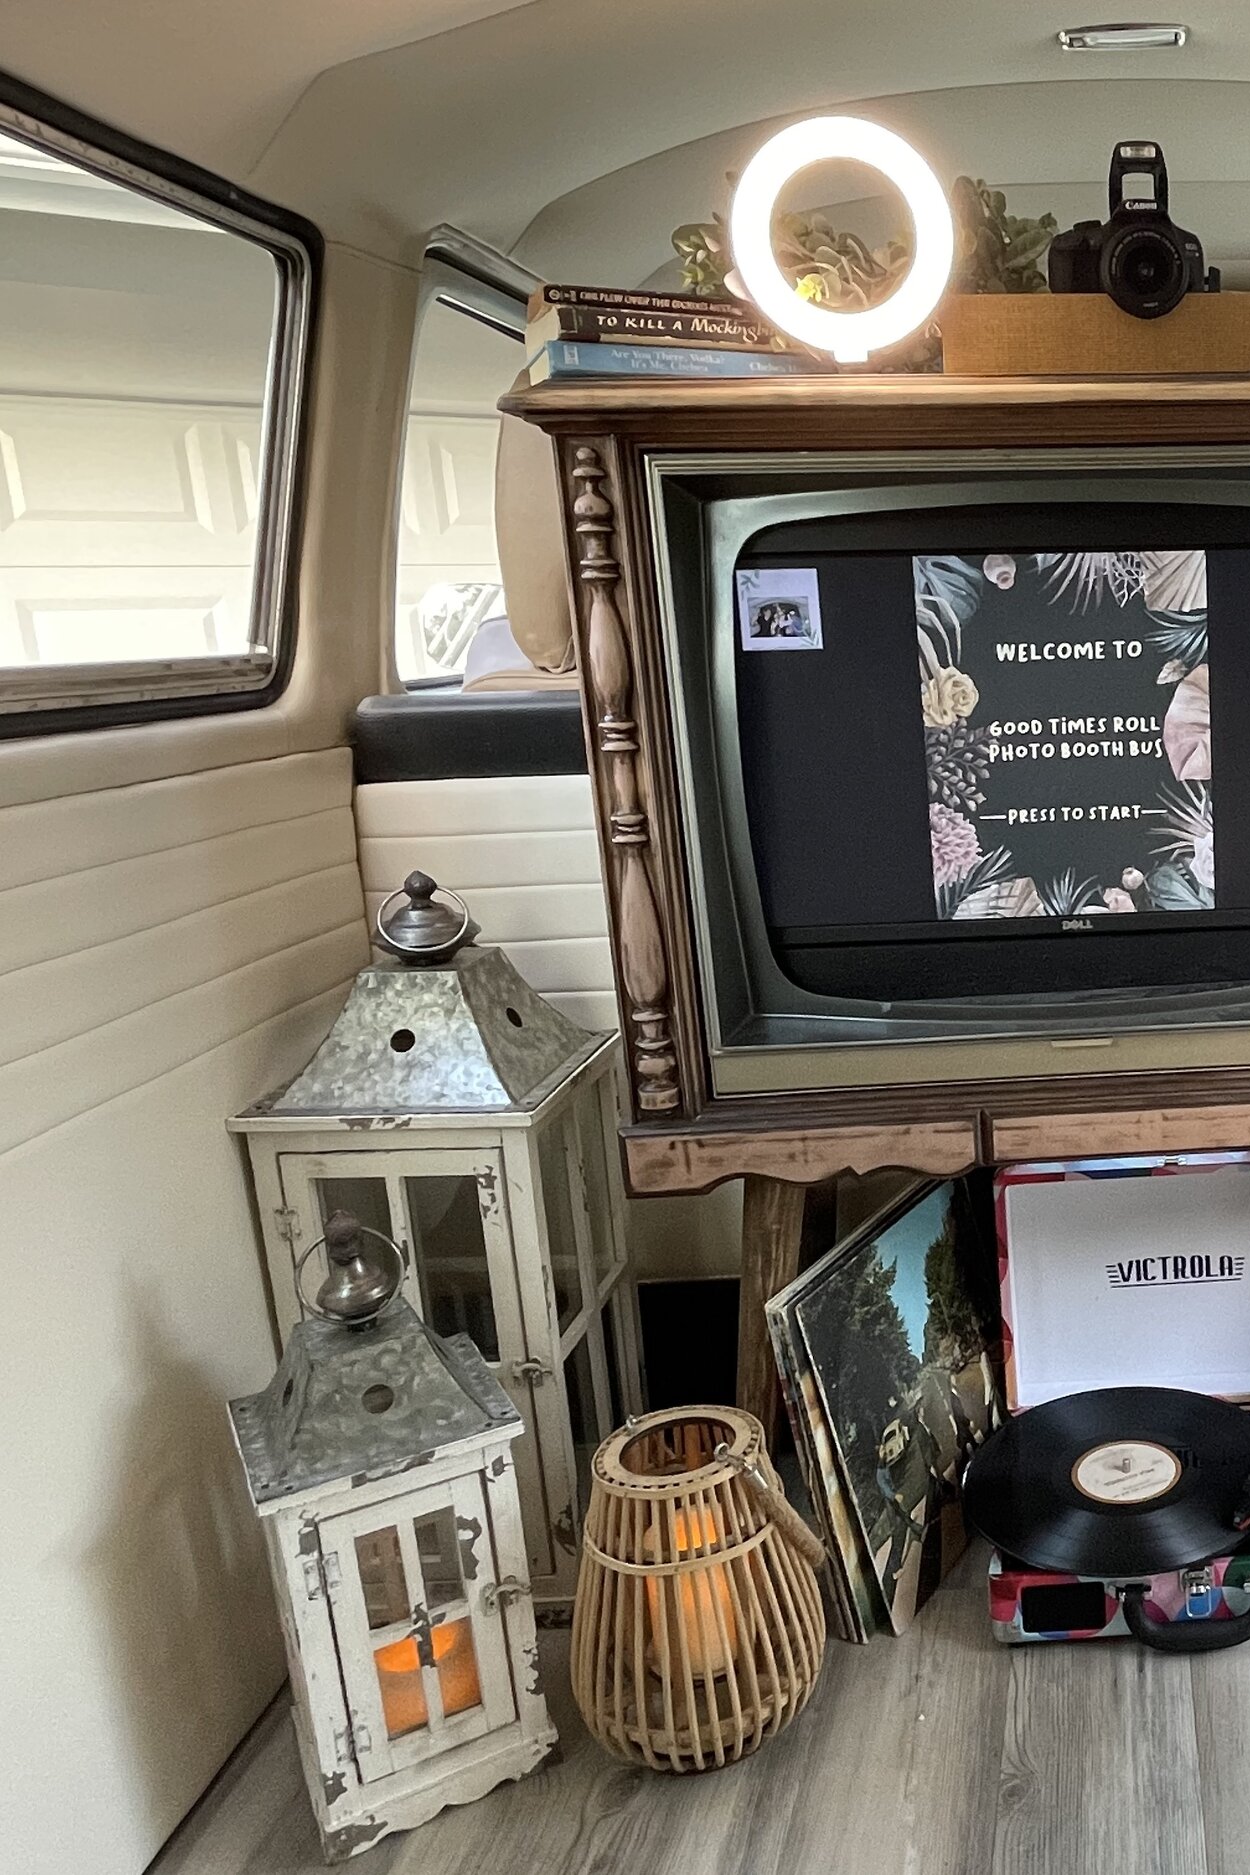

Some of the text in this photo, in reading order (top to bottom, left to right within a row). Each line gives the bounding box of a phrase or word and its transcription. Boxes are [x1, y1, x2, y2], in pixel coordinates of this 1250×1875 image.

[596, 315, 618, 327] TO
[625, 316, 667, 331] KILL
[672, 320, 683, 332] A
[611, 349, 629, 360] Are
[632, 350, 652, 361] You
[995, 639, 1144, 663] WELCOME TO
[989, 719, 1044, 737] GOOD
[1113, 716, 1161, 733] ROLL
[988, 738, 1163, 763] PHOTO BOOTH BUS
[1008, 804, 1142, 826] PRESS TO START
[1061, 919, 1094, 931] DELL
[1117, 1255, 1234, 1283] VICTROLA
